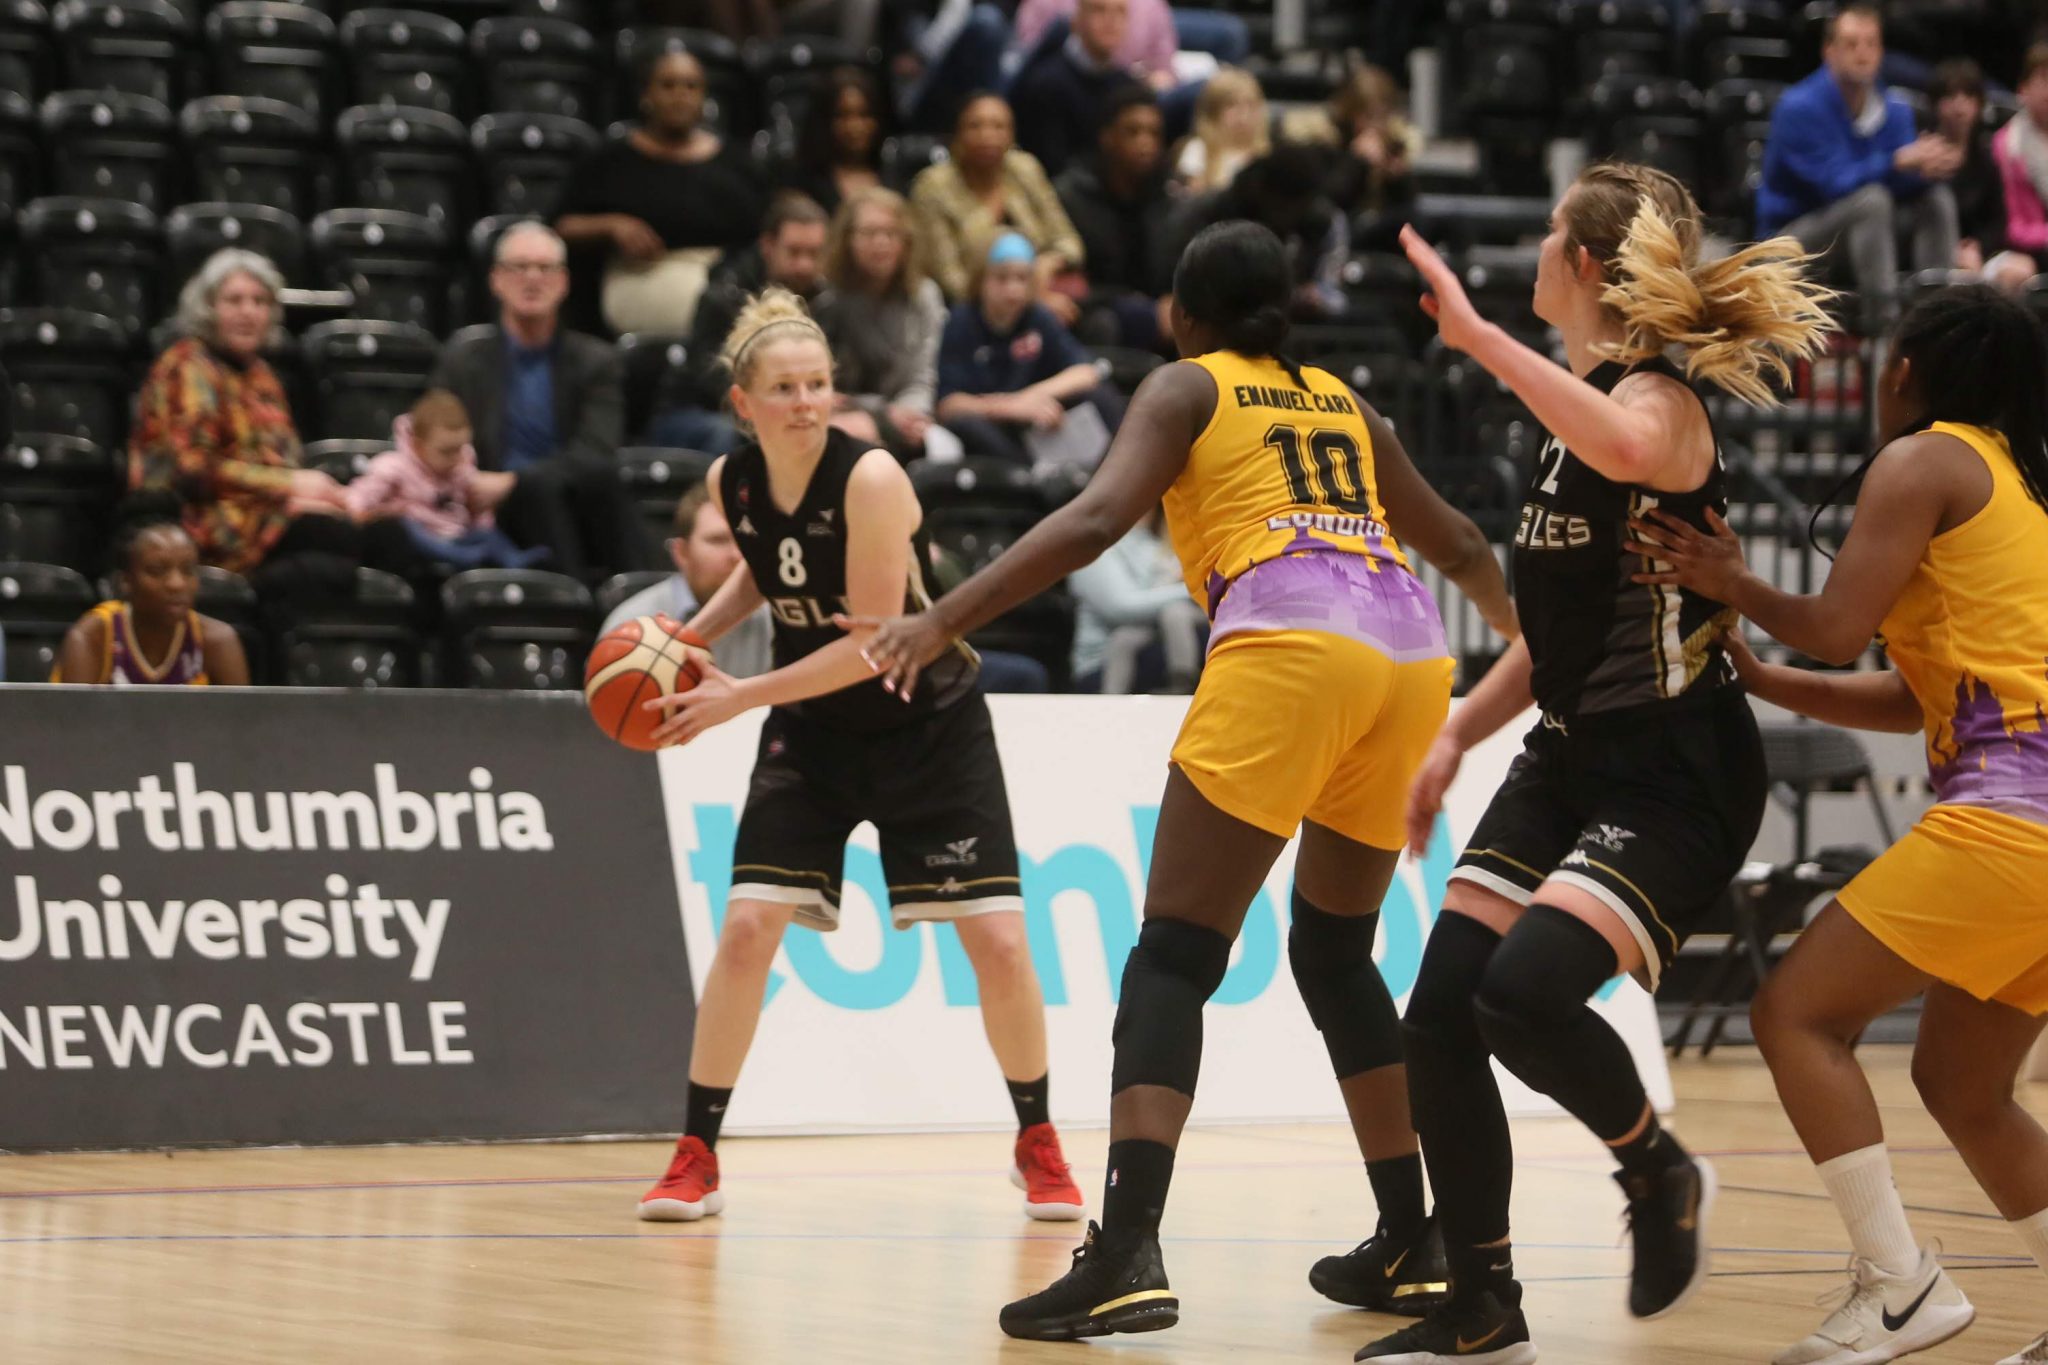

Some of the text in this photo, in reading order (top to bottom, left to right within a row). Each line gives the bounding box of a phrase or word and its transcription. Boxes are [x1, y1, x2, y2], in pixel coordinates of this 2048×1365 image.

[1233, 384, 1314, 411] EMANUEL
[1264, 423, 1372, 515] 10
[778, 537, 807, 587] 8
[0, 1001, 474, 1069] NEWCASTLE
